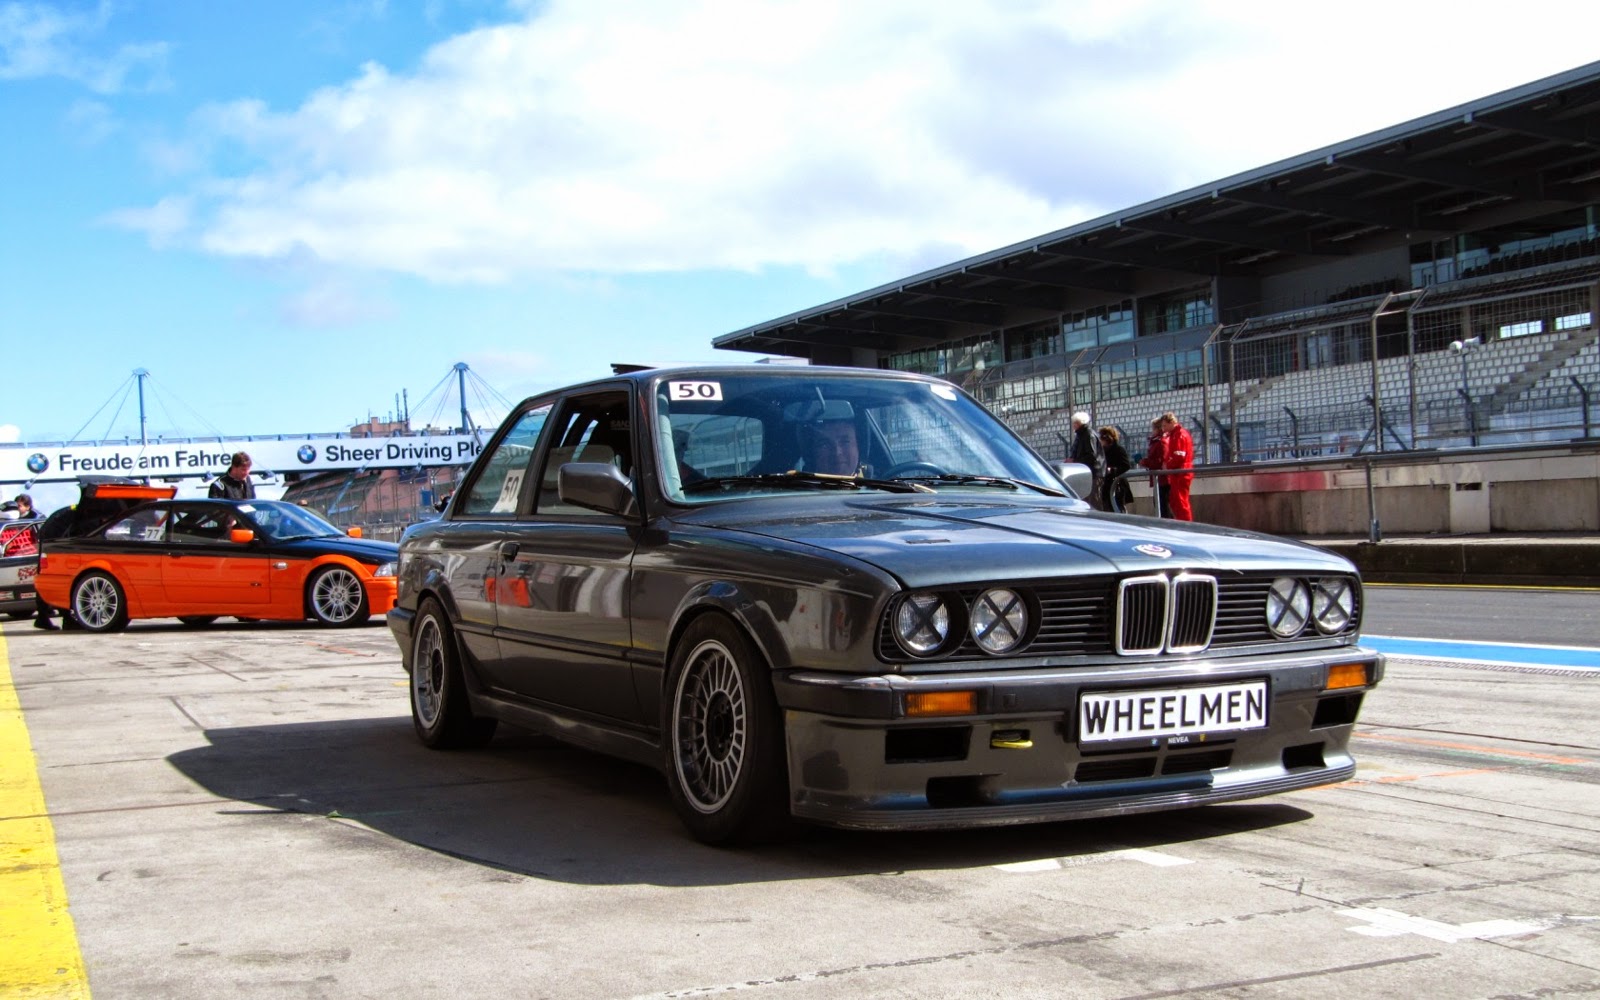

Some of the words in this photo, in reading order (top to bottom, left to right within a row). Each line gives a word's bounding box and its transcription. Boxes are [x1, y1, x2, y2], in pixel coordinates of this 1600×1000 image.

[678, 383, 716, 398] 50
[59, 453, 133, 471] Freude
[138, 453, 170, 468] am
[175, 450, 232, 467] Fahre
[325, 444, 382, 462] Sheer
[387, 442, 452, 462] Driving
[501, 476, 520, 502] 50
[146, 529, 160, 539] 77
[1084, 688, 1264, 734] WHEELMEN
